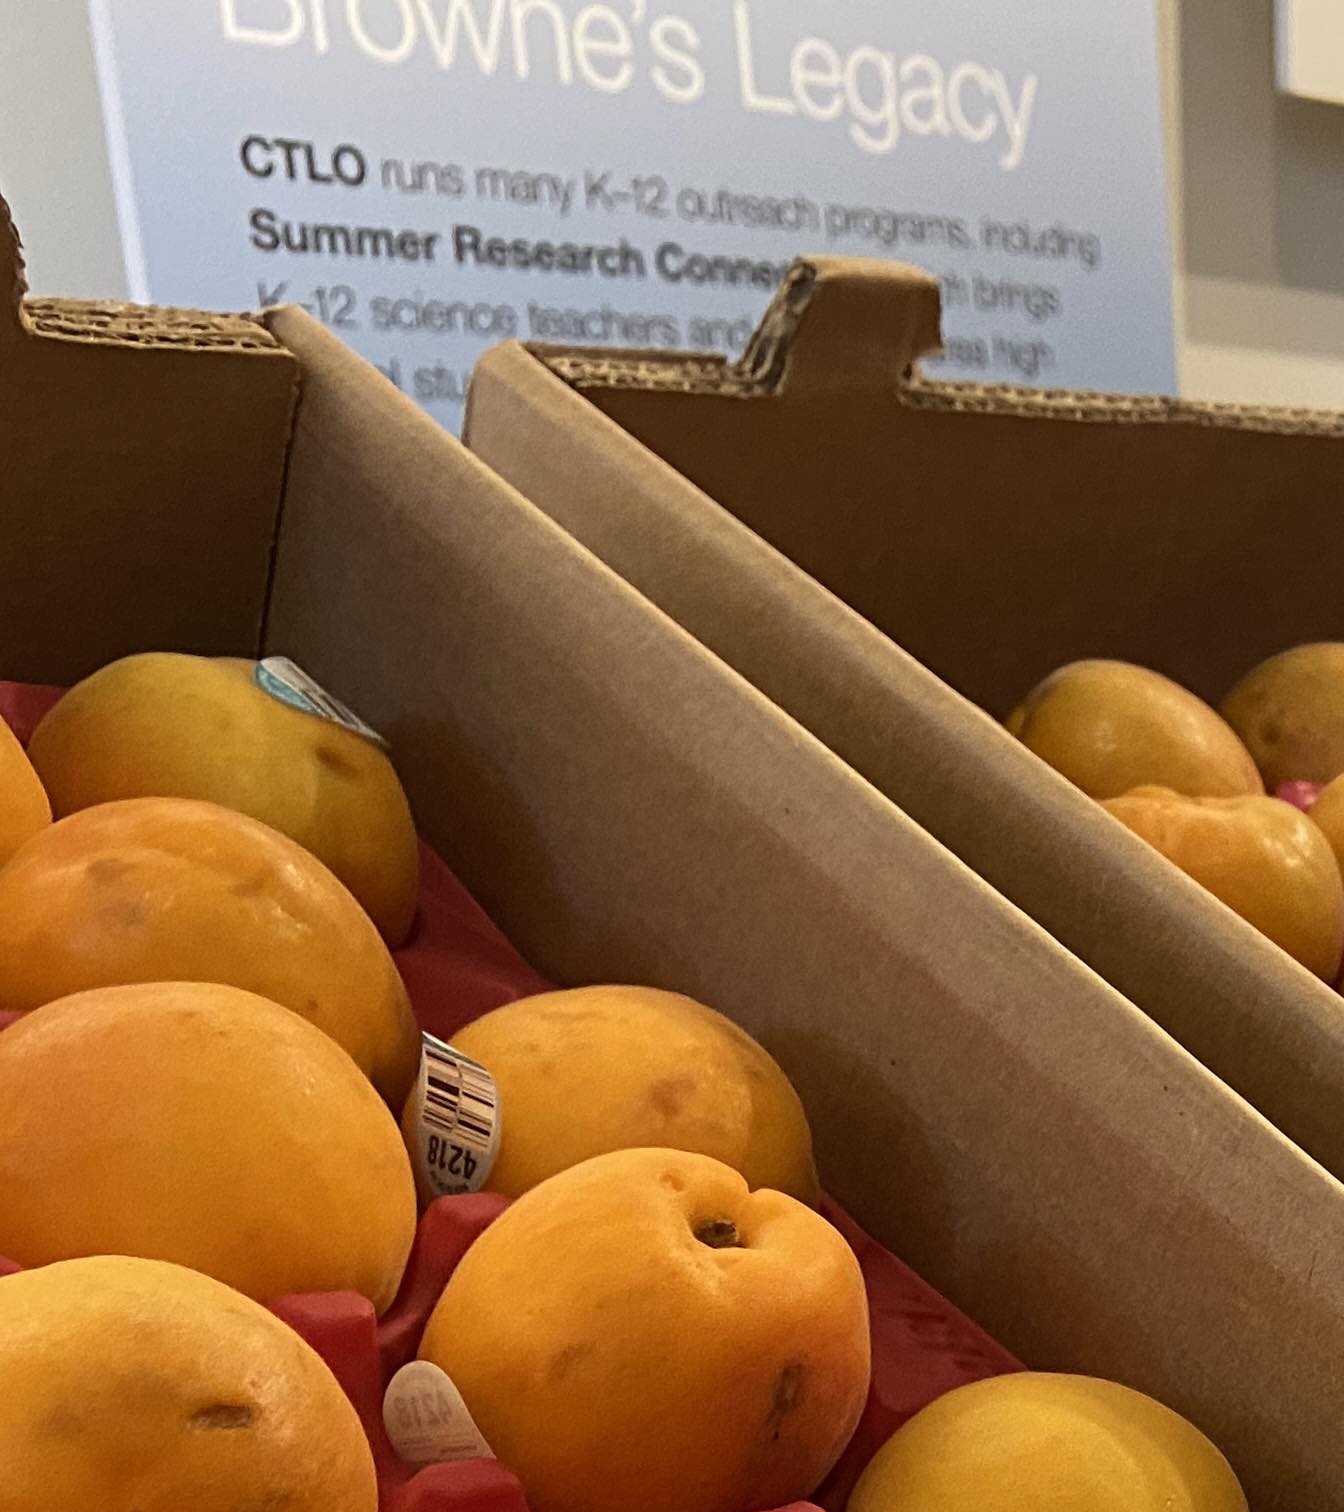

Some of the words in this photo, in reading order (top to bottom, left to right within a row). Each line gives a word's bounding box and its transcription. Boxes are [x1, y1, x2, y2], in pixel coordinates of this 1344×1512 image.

[733, 0, 1038, 172] Legacy
[239, 134, 368, 188] CTLO
[379, 157, 465, 198] runs
[474, 164, 573, 217] many
[249, 207, 441, 262] Summer
[453, 224, 646, 280] Research
[369, 290, 517, 336] science
[526, 303, 682, 347] teachers
[427, 1134, 477, 1180] 4218
